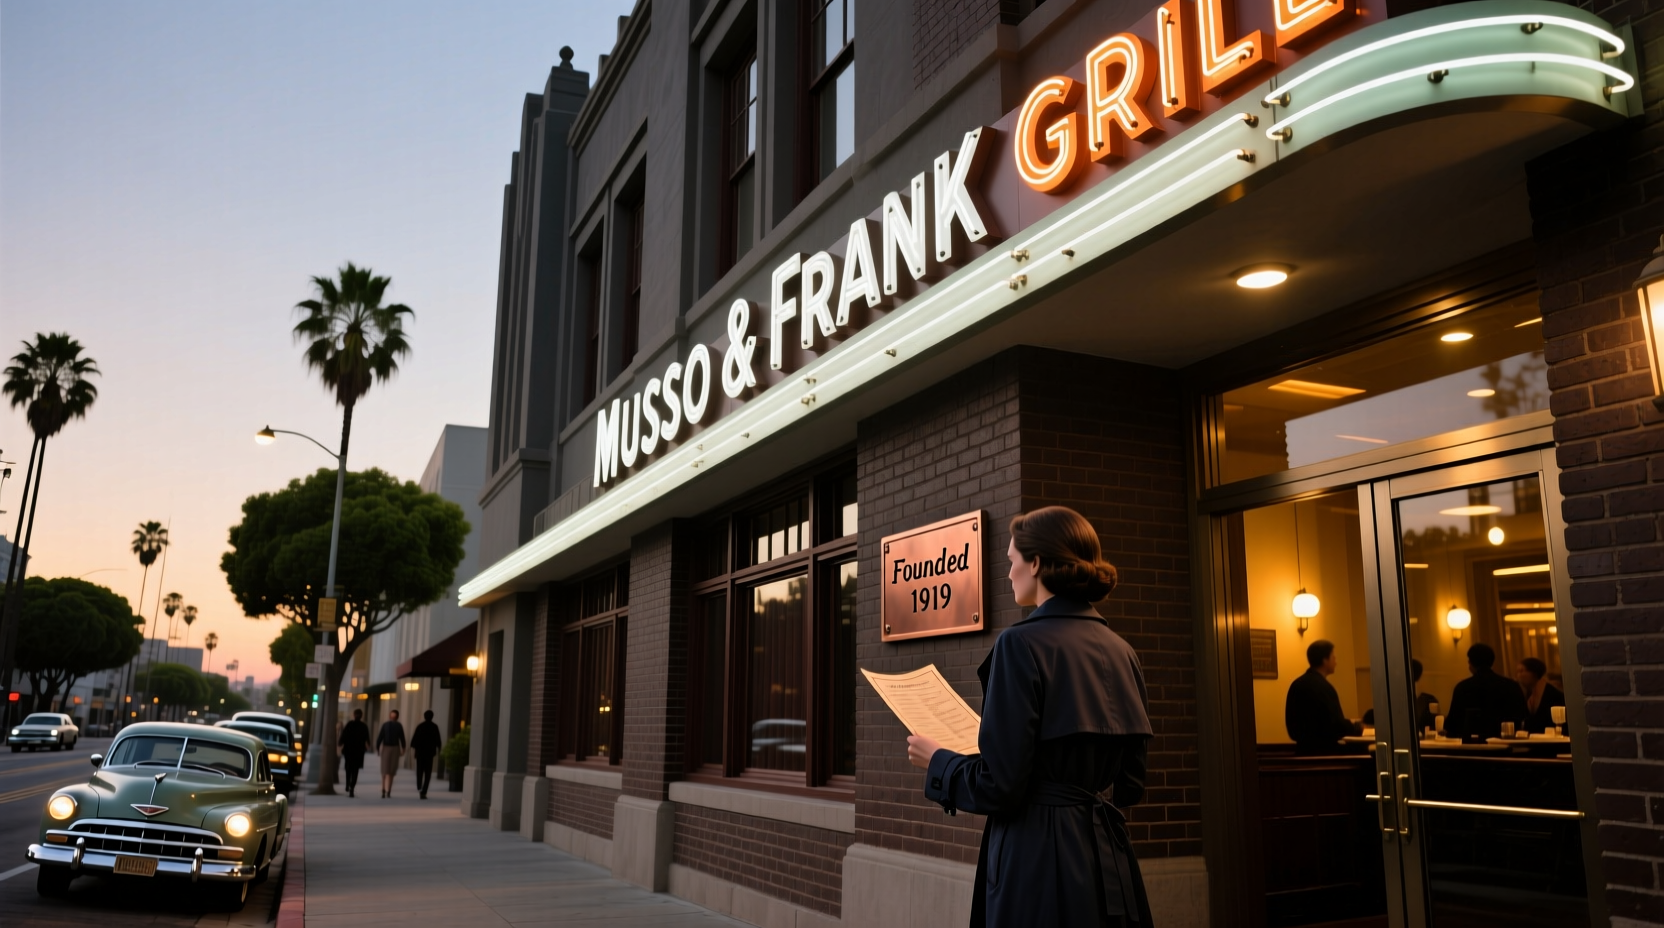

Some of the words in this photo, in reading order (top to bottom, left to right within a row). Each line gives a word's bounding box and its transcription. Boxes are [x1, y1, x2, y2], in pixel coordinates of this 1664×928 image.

[593, 343, 711, 488] MUSSO
[721, 298, 757, 399] &
[770, 126, 988, 370] FRANK
[891, 542, 970, 585] Founded
[910, 583, 952, 614] 1919
